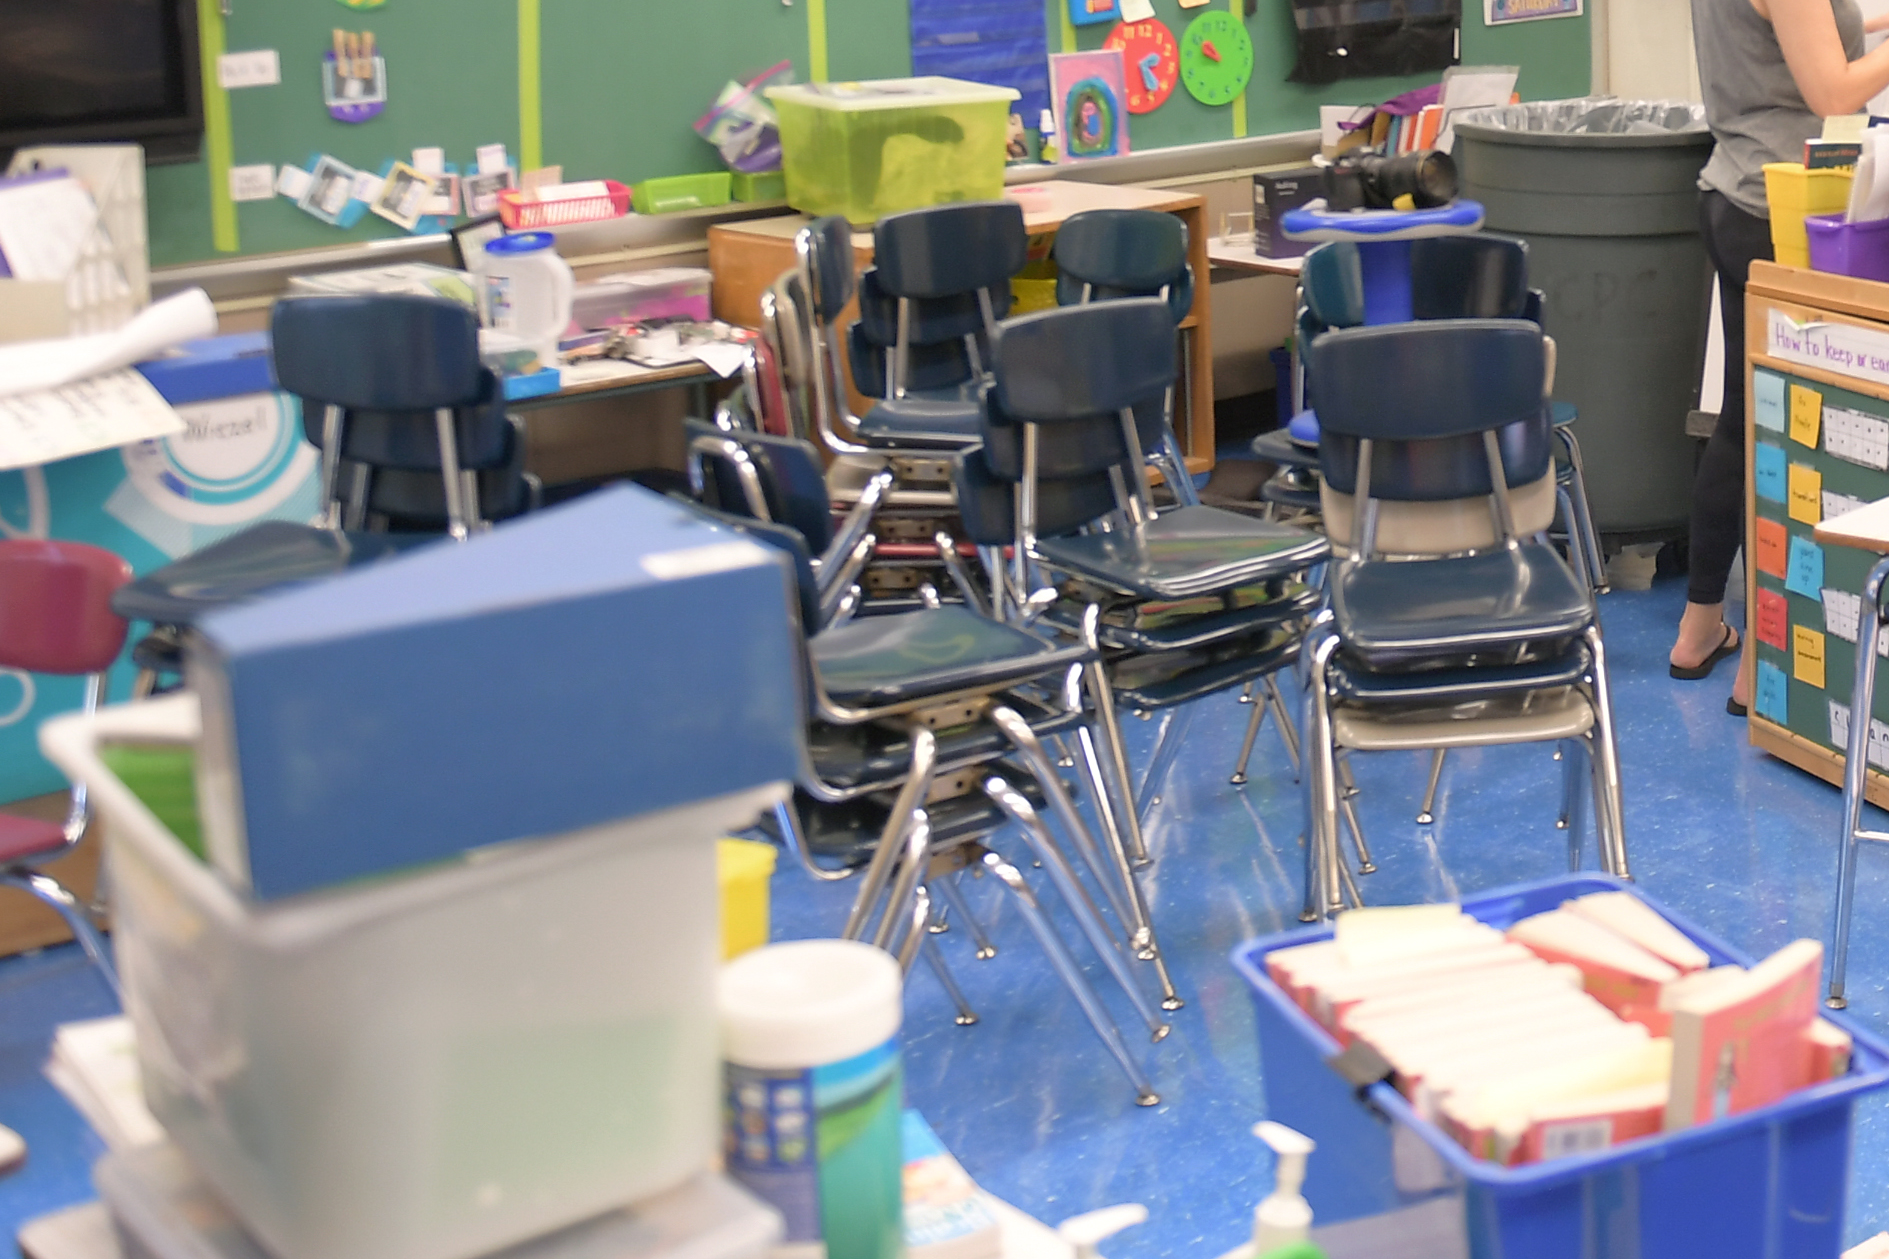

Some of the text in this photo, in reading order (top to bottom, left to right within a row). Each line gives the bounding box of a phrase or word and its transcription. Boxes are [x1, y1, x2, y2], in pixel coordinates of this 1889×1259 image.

[1138, 24, 1152, 37] 12
[1775, 323, 1801, 352] How
[1805, 331, 1820, 356] to
[1825, 335, 1853, 367] keep
[1858, 354, 1867, 367] or
